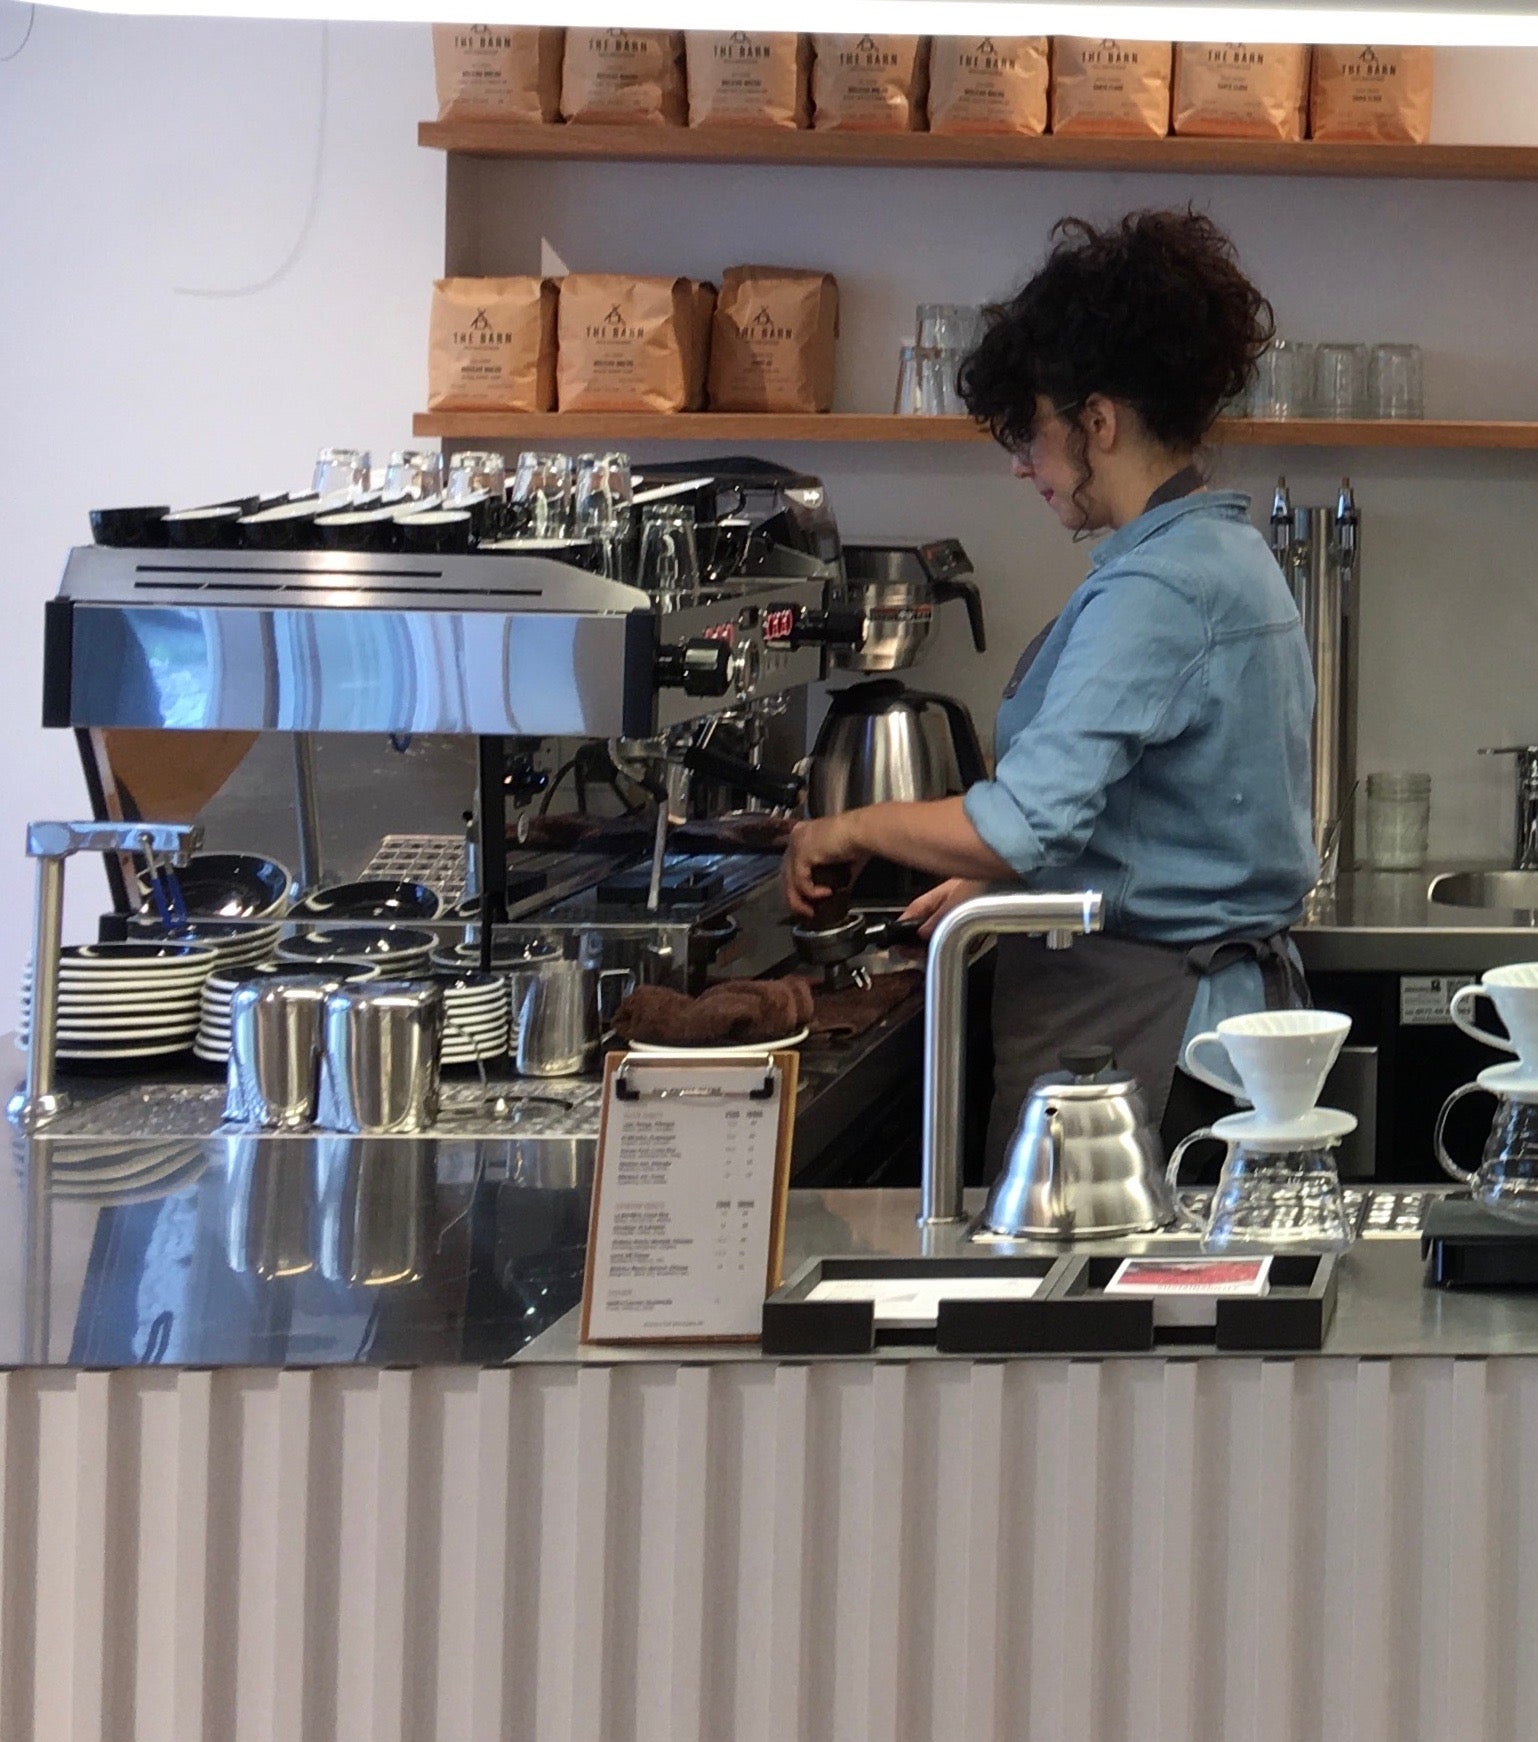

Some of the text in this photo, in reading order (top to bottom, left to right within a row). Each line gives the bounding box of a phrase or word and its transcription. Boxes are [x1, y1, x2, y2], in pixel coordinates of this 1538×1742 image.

[455, 36, 511, 48] THE BARN
[589, 38, 647, 52] THE BARN
[714, 45, 770, 58] THE BARN
[1082, 52, 1138, 64] THE BARN
[1208, 51, 1264, 65] THE BARN
[840, 53, 898, 66] THE BARN
[959, 55, 1016, 69] THE BARN
[1342, 64, 1397, 76] THE BARN
[453, 332, 512, 344] THE BARN
[586, 326, 644, 339] THE BARN
[735, 327, 793, 340] THE BARN
